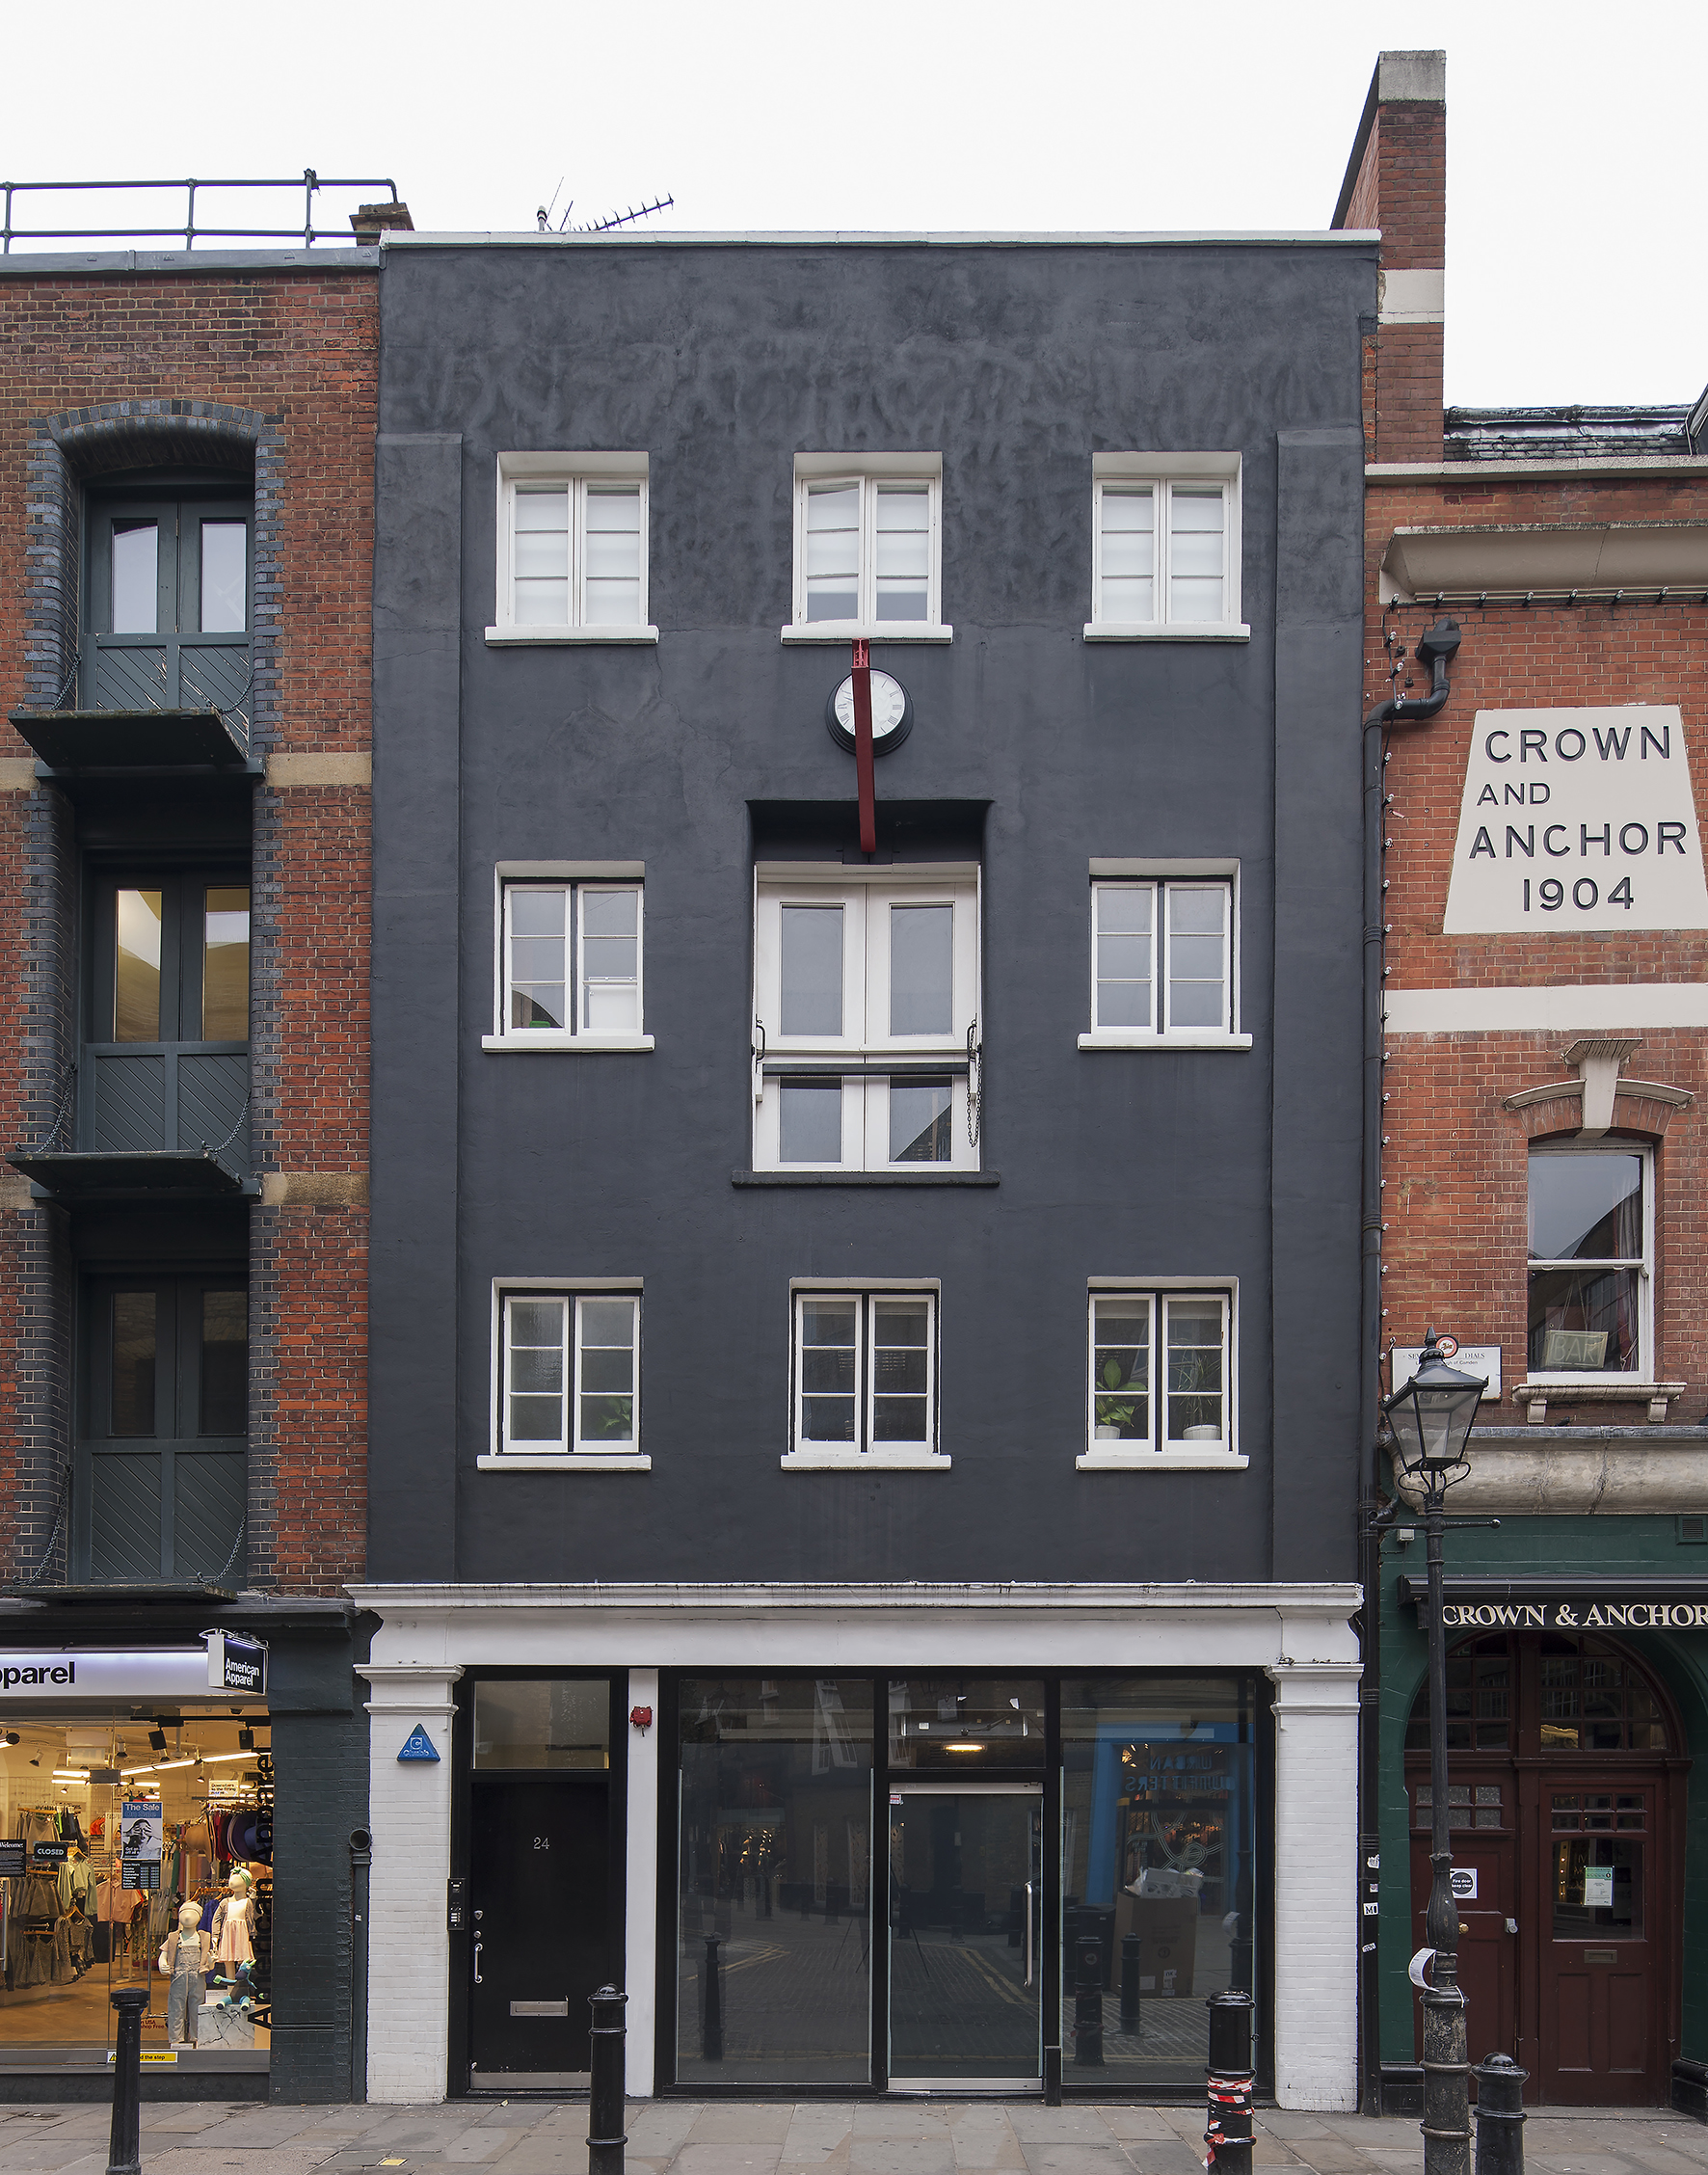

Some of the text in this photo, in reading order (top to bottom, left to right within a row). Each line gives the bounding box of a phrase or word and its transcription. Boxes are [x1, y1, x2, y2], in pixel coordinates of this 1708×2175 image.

[1484, 725, 1670, 764] CROWN
[1476, 782, 1551, 806] AND
[1468, 821, 1687, 859] ANCHOR
[1523, 876, 1634, 912] 1904
[1554, 1335, 1596, 1362] BAR
[1442, 1603, 1548, 1627] CROWN
[1555, 1603, 1579, 1627] &
[0, 1661, 75, 1689] parel
[225, 1657, 260, 1677] American
[225, 1669, 254, 1687] Apparel
[142, 1803, 160, 1812] Sale
[533, 1837, 550, 1849] 24
